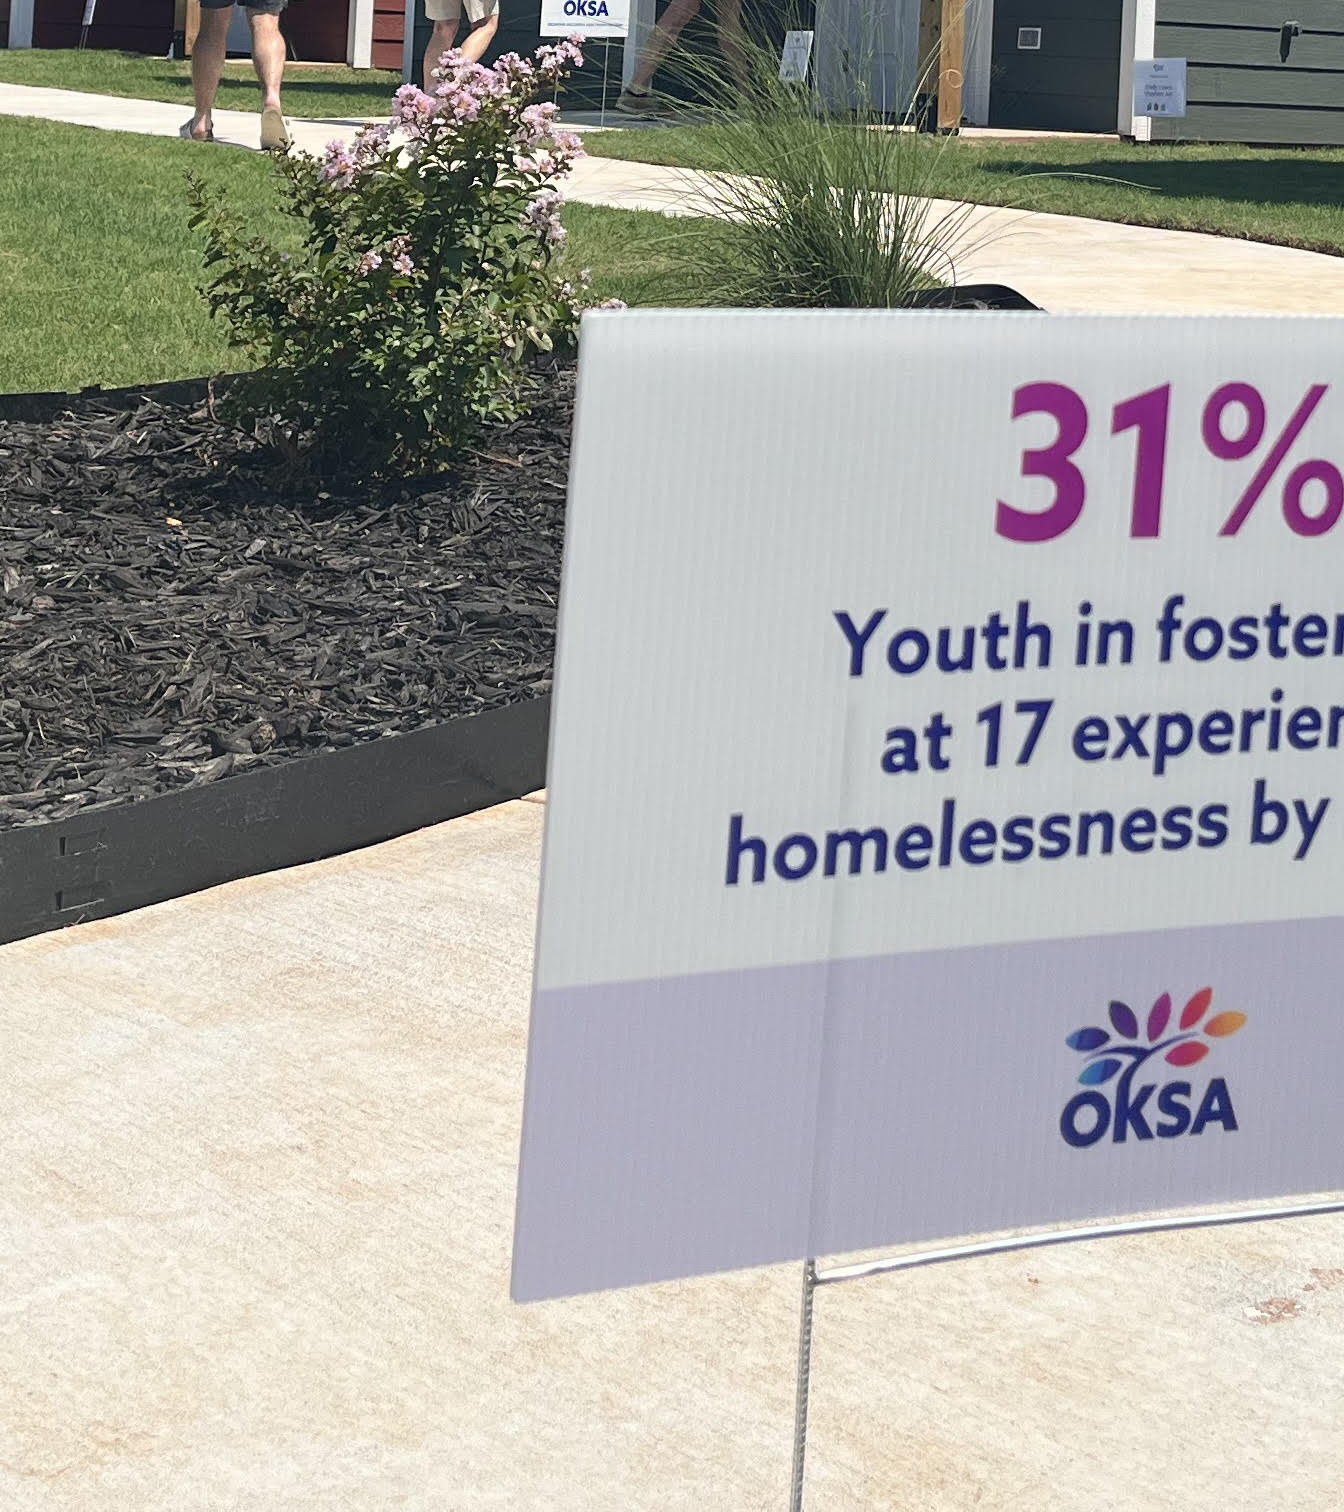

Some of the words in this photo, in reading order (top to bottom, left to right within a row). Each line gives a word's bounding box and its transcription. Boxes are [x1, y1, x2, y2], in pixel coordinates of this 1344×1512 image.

[563, 0, 609, 17] OKSA
[835, 601, 1051, 676] Youth
[1076, 601, 1133, 665] in
[882, 714, 952, 773] at
[978, 699, 1054, 767] 17
[725, 799, 1229, 884] homelessness
[1250, 783, 1328, 860] by
[1060, 1078, 1238, 1148] OKSA
